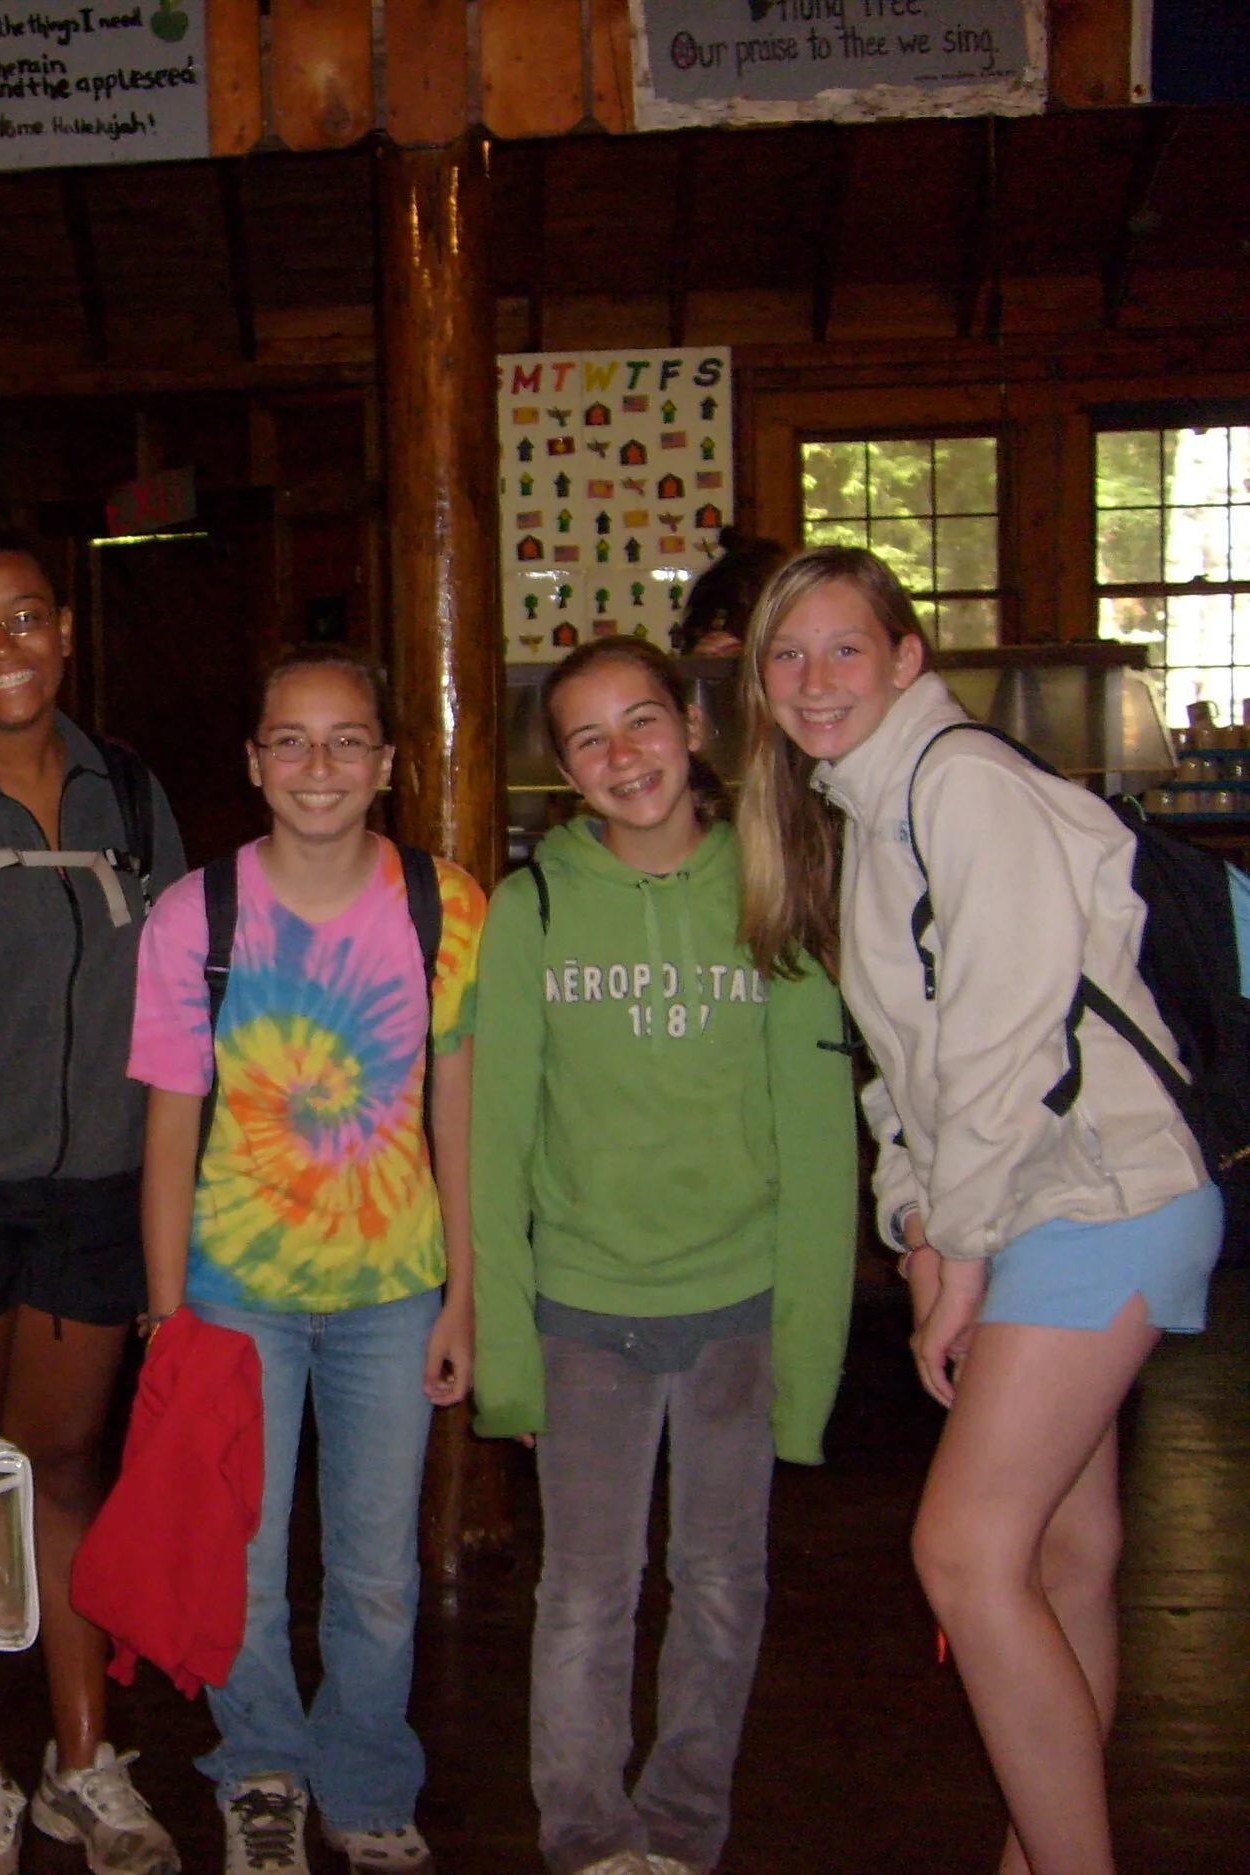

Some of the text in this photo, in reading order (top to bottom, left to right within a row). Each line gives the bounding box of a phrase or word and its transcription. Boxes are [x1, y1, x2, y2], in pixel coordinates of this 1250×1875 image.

[29, 13, 77, 45] things
[82, 9, 94, 32] I
[100, 7, 142, 28] need
[17, 54, 66, 75] rain
[671, 32, 727, 70] Our
[735, 33, 798, 76] praise
[807, 27, 831, 60] to
[898, 34, 931, 54] we
[24, 77, 70, 100] the
[75, 55, 196, 101] appleseed
[512, 357, 724, 394] M T W T F S
